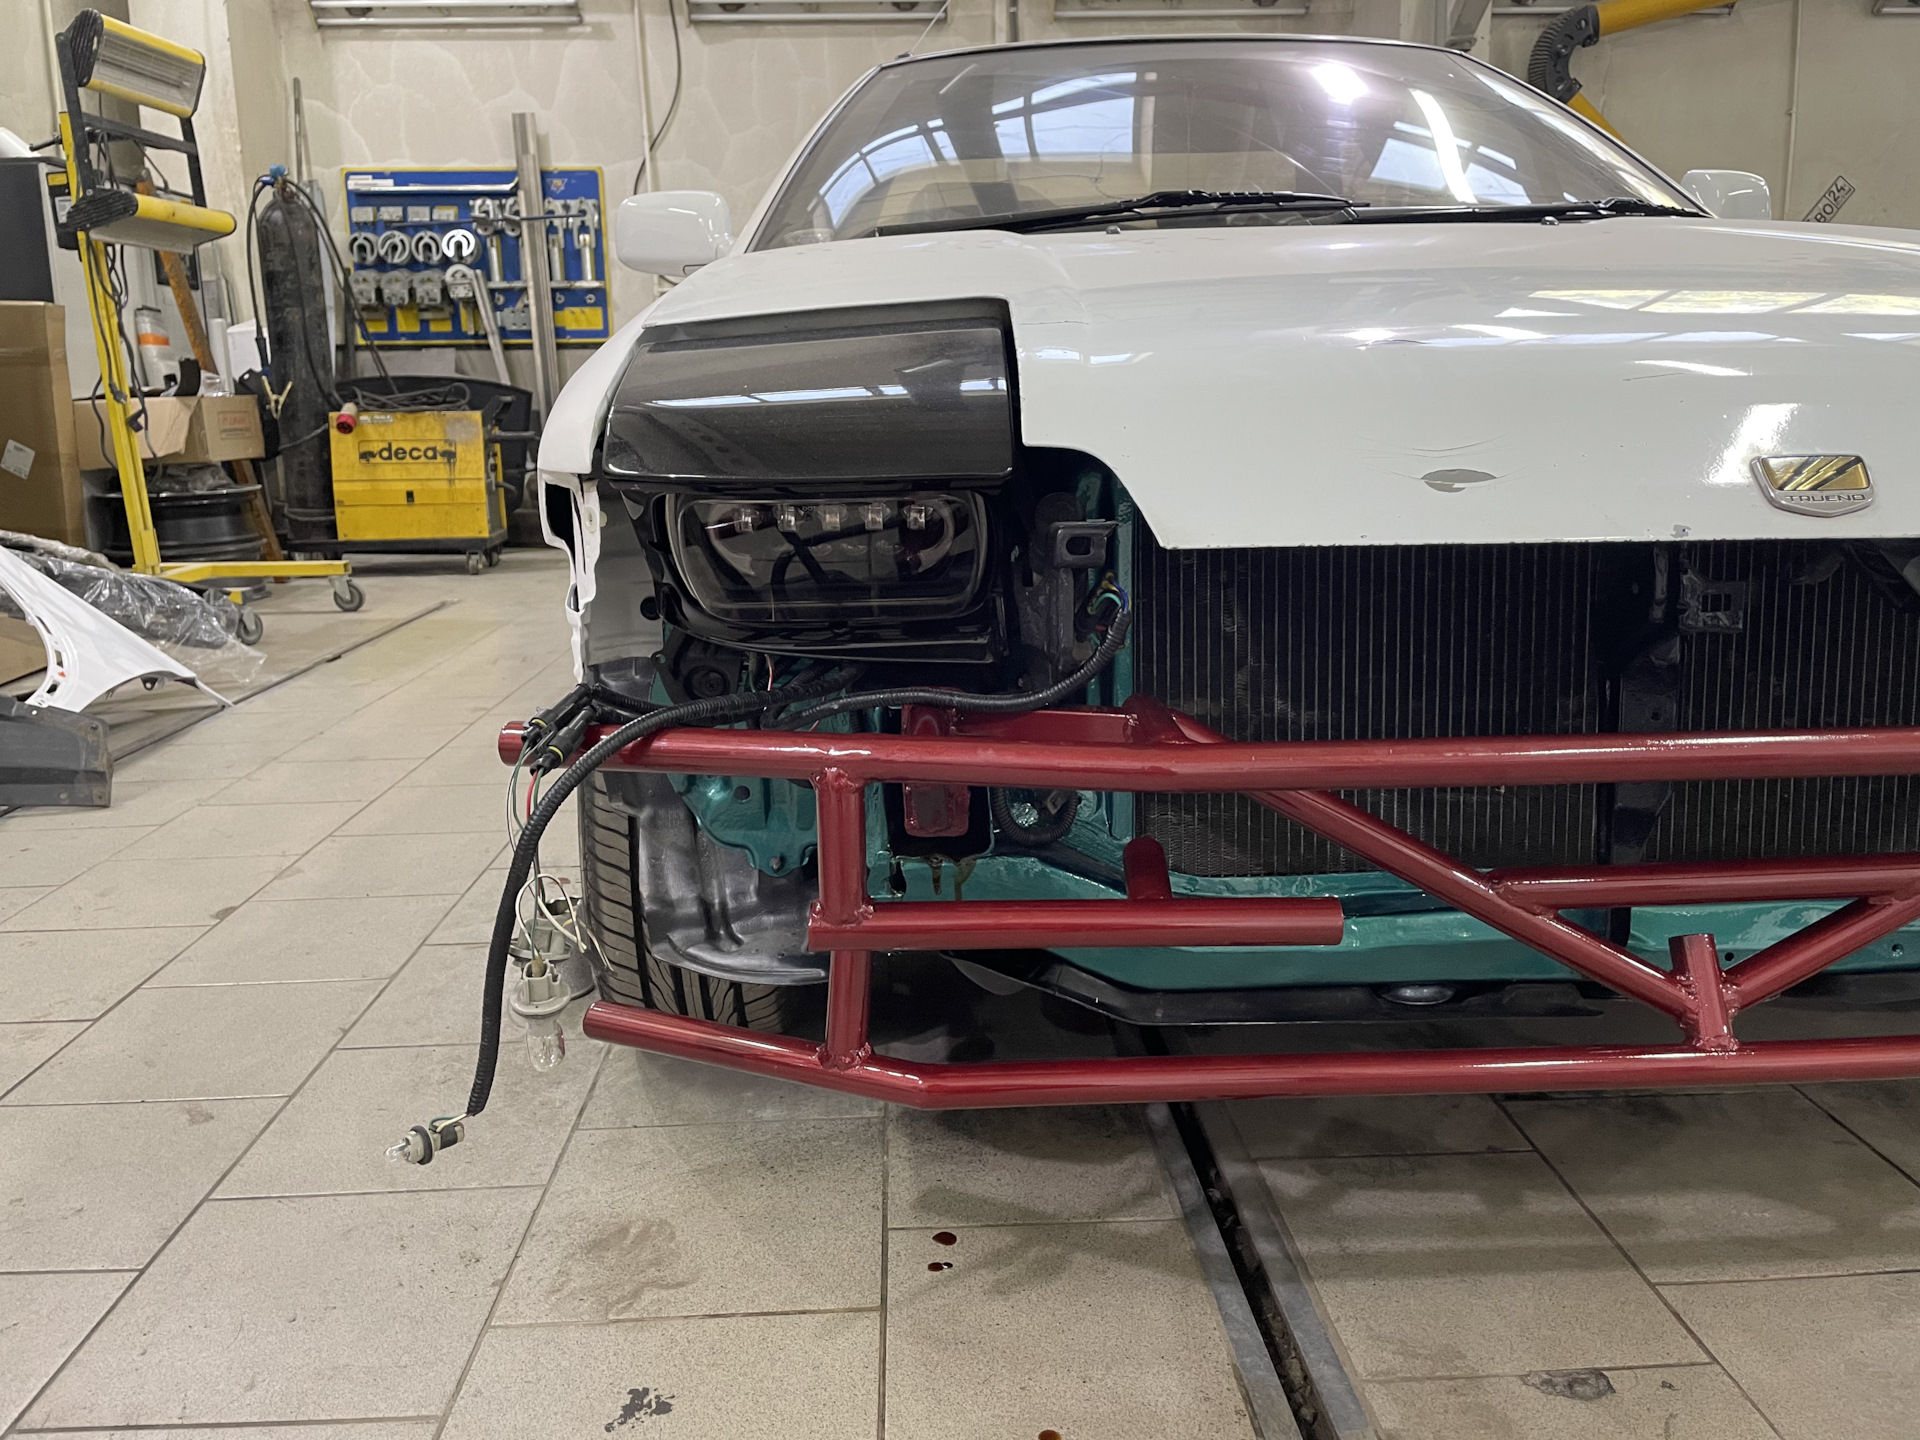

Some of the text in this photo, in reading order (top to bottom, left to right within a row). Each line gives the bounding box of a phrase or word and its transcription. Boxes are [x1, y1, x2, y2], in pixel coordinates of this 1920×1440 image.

[1828, 182, 1847, 202] 24
[378, 441, 438, 461] deca
[1785, 493, 1866, 503] TRUENO
